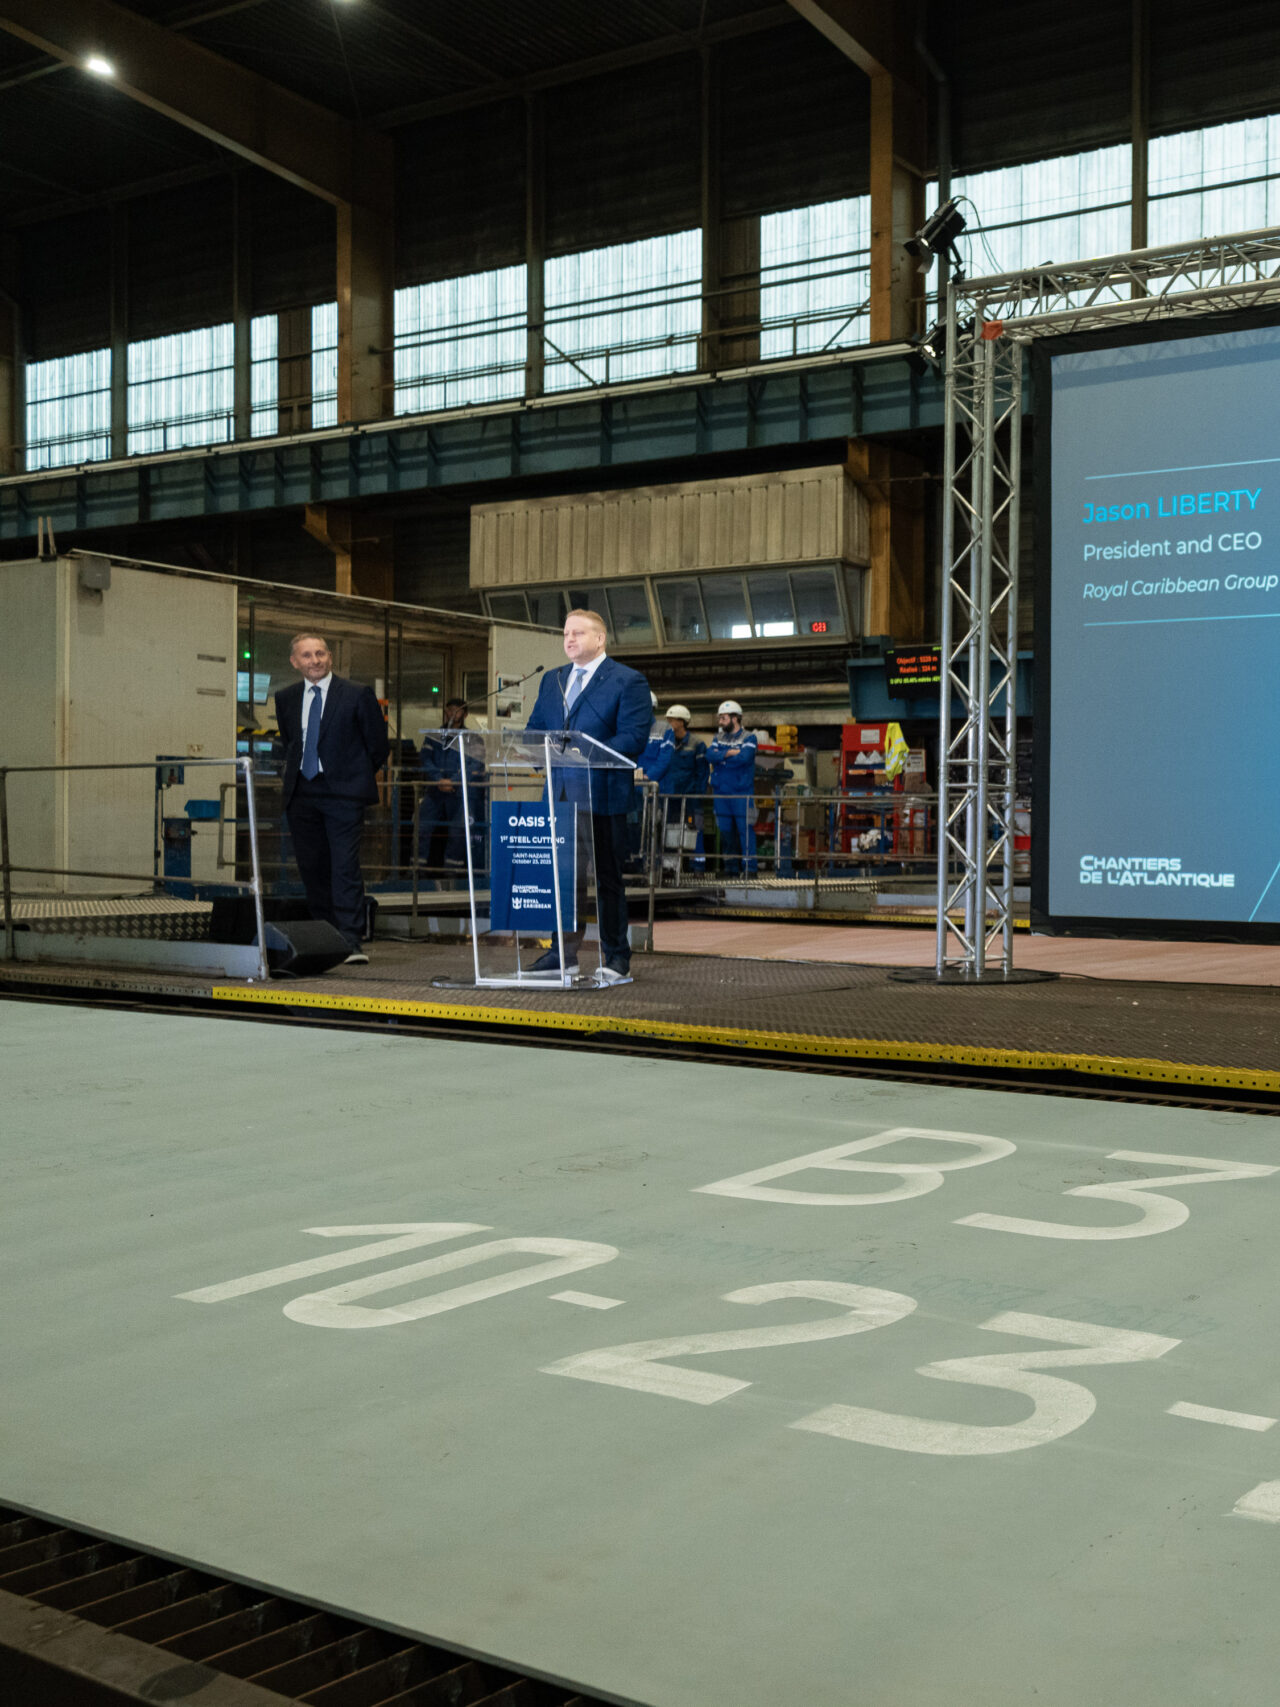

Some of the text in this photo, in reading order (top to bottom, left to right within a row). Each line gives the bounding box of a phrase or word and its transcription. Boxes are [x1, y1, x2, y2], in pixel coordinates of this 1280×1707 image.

[1082, 488, 1262, 523] Jason LIBERTY
[1083, 531, 1262, 561] President and CEO
[1083, 573, 1279, 601] Royal Caribbean Group
[508, 816, 545, 827] OASIS
[509, 835, 531, 844] STEEL
[1080, 855, 1181, 871] CHANTIERS
[1080, 871, 1235, 888] DE L'ATLANTIQUE
